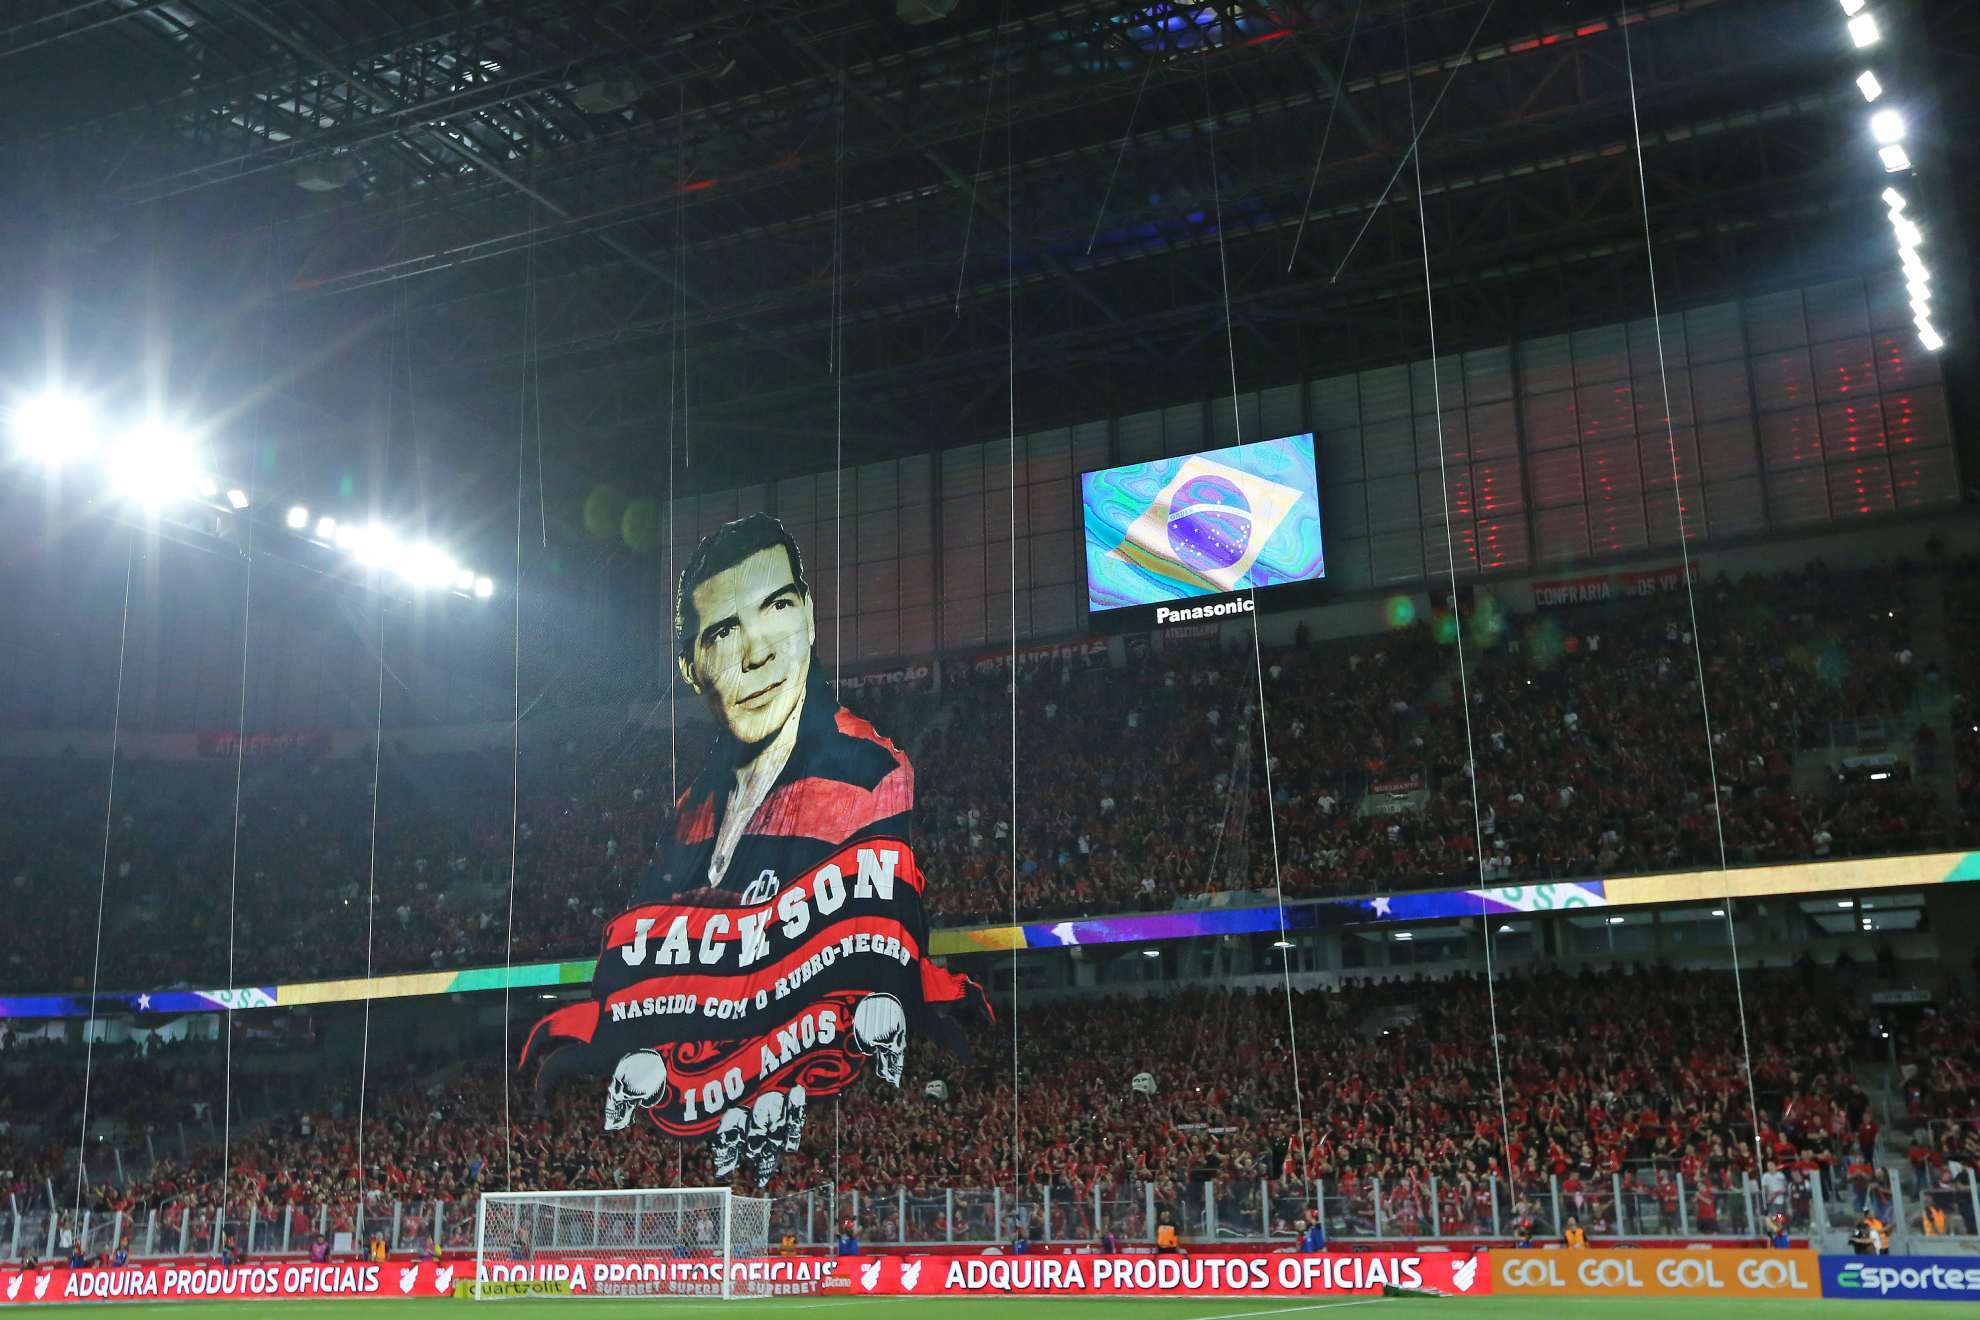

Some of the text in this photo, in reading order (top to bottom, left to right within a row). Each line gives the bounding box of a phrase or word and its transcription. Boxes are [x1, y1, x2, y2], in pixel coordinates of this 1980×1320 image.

[1535, 581, 1611, 607] CONFRARIA
[1156, 597, 1255, 625] Panasonic
[621, 848, 900, 967] JACKSON
[611, 932, 911, 1022] NASCIDO COM O RUBRO-NEGRO
[683, 1010, 838, 1122] 100 ANOS
[64, 1265, 380, 1298] ADQUIRA PRODUTOS OFICIAIS
[668, 1281, 736, 1296] SUPERBT
[747, 1281, 818, 1295] SUPERBET
[945, 1257, 1422, 1291] ADQUIRA PRODUTOS OFICIAIS
[1502, 1258, 1808, 1289] GOL GOL GOL GOL
[1837, 1262, 1980, 1295] Esportes
